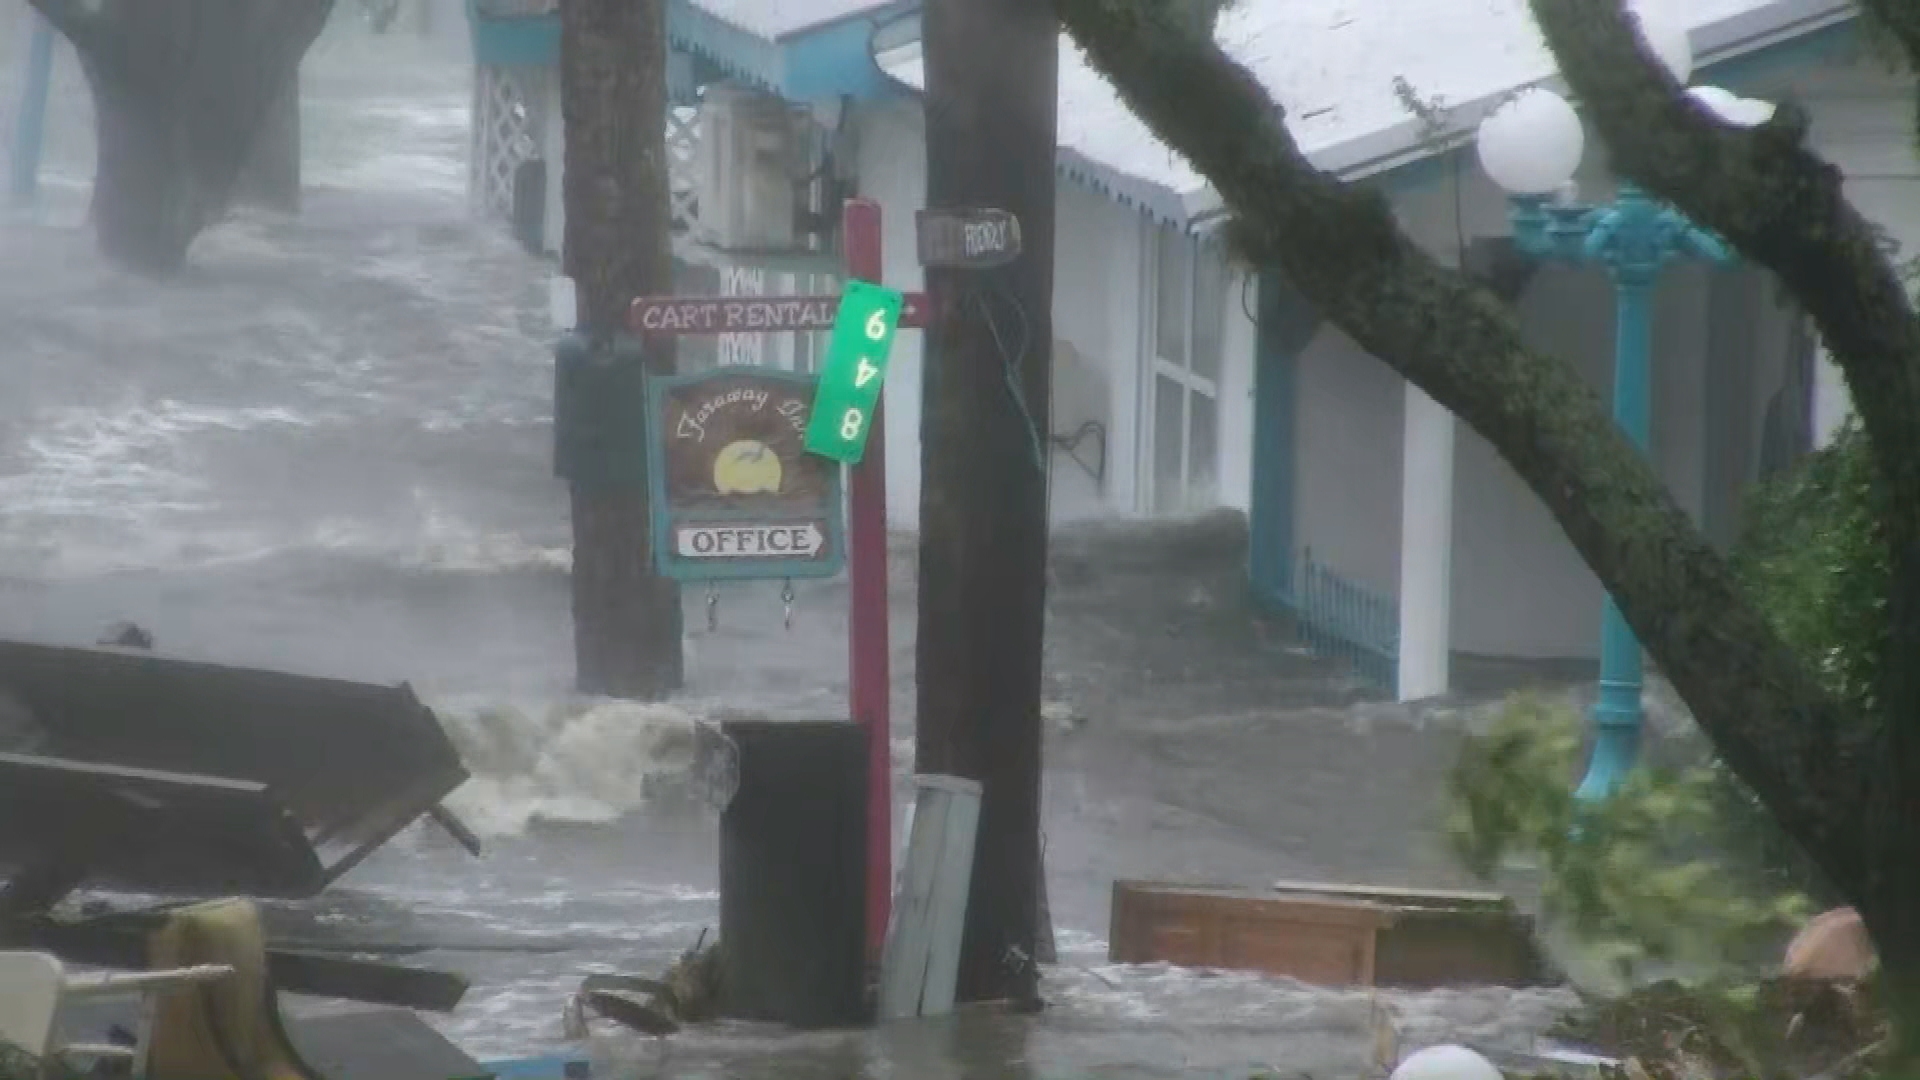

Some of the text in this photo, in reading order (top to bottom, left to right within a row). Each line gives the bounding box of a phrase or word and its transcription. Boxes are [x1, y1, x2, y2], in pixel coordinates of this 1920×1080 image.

[643, 303, 717, 328] CART
[677, 388, 769, 442] Faraway
[692, 529, 811, 553] OFFICE
